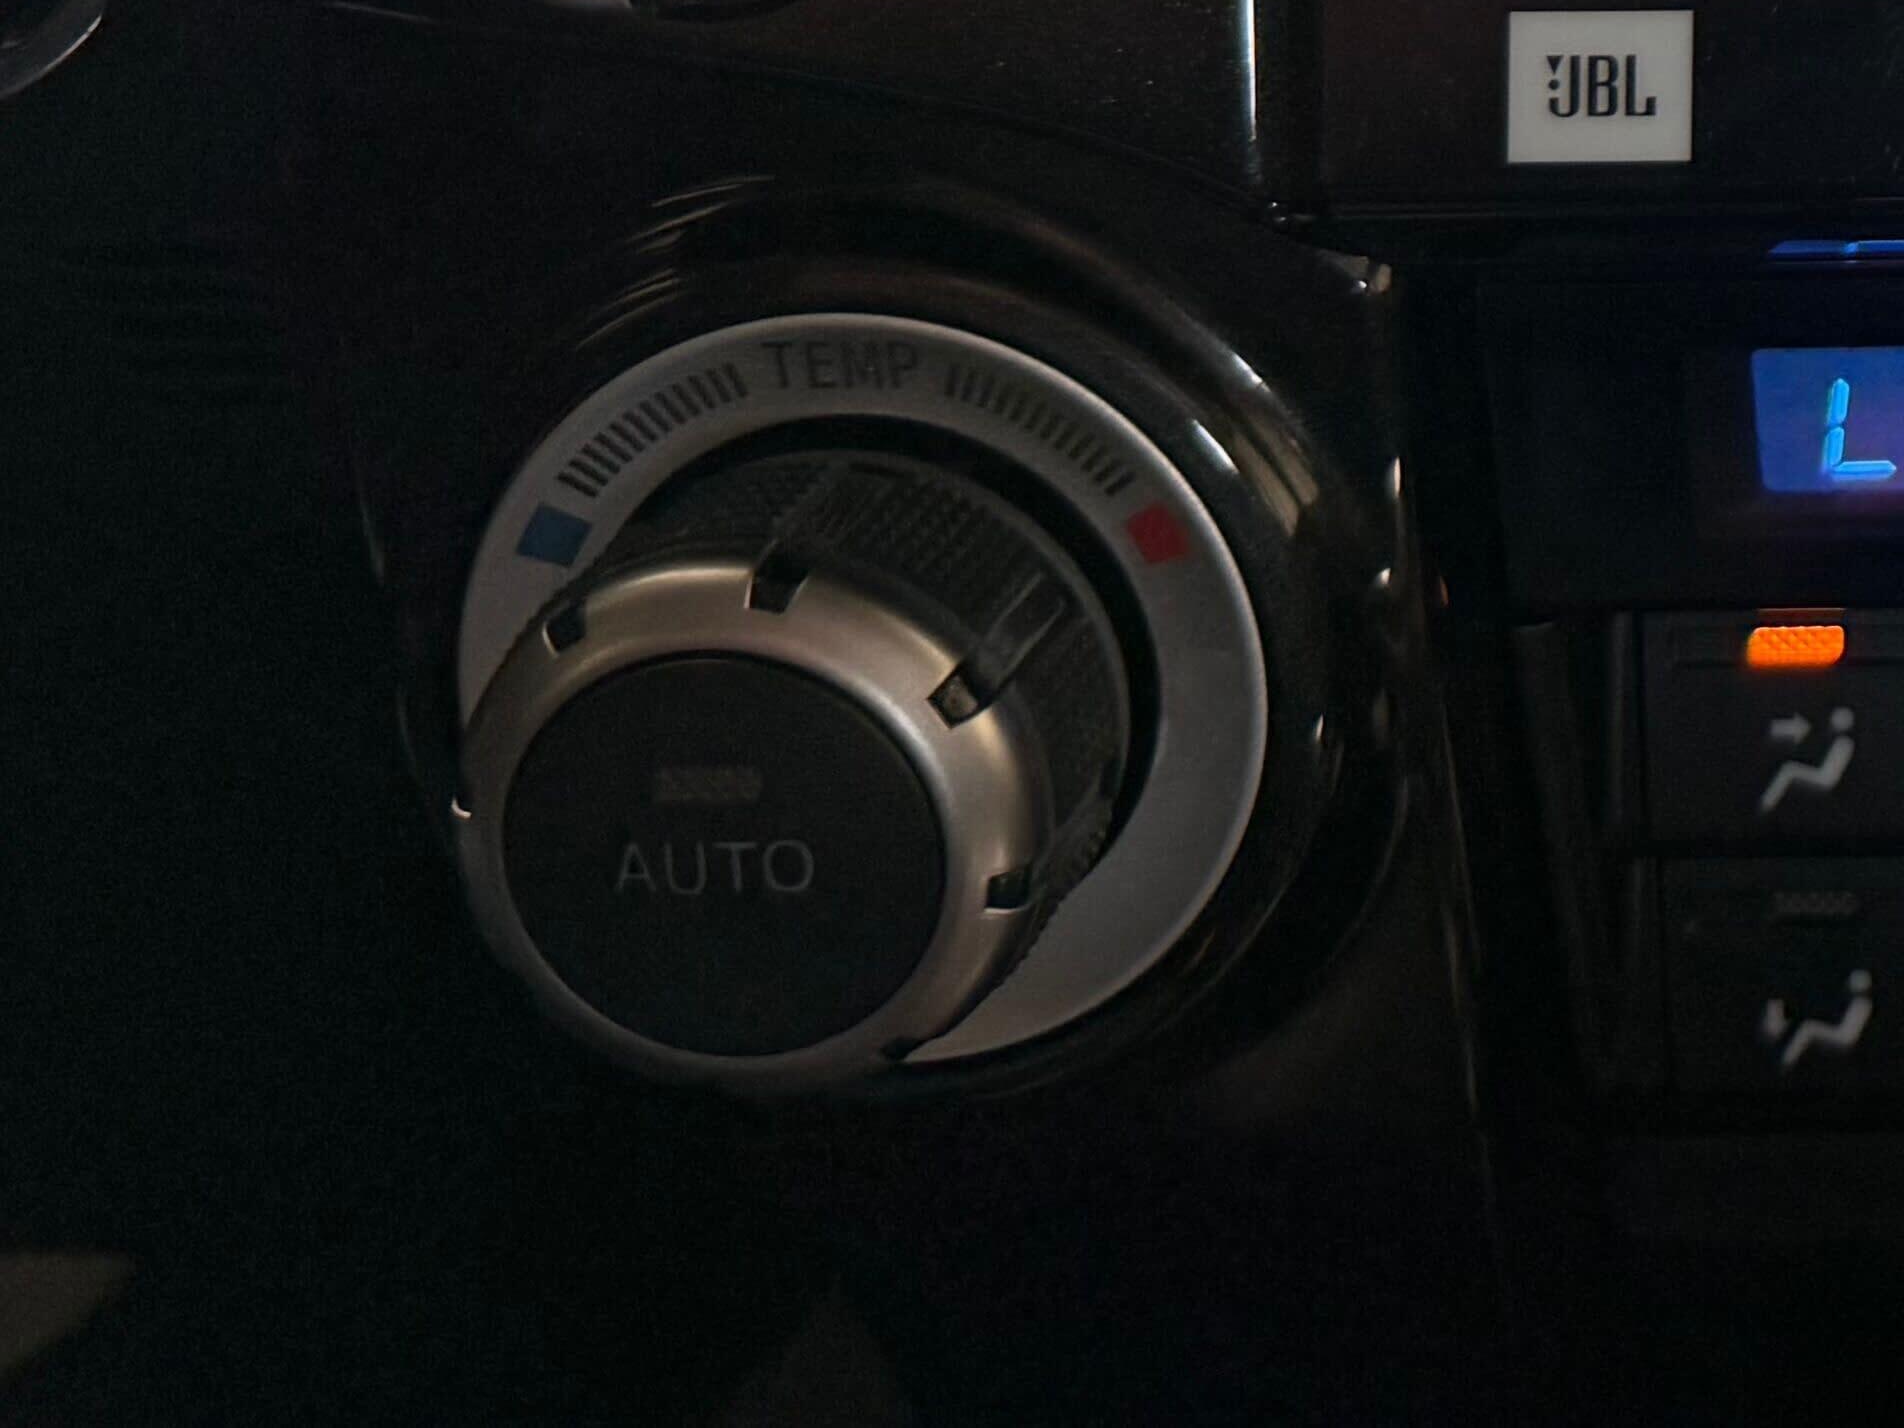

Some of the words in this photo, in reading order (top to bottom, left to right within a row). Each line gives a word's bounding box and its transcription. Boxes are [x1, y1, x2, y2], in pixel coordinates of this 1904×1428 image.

[1546, 54, 1657, 118] JBL
[762, 341, 919, 390] TEMP
[614, 838, 816, 895] AUTO
